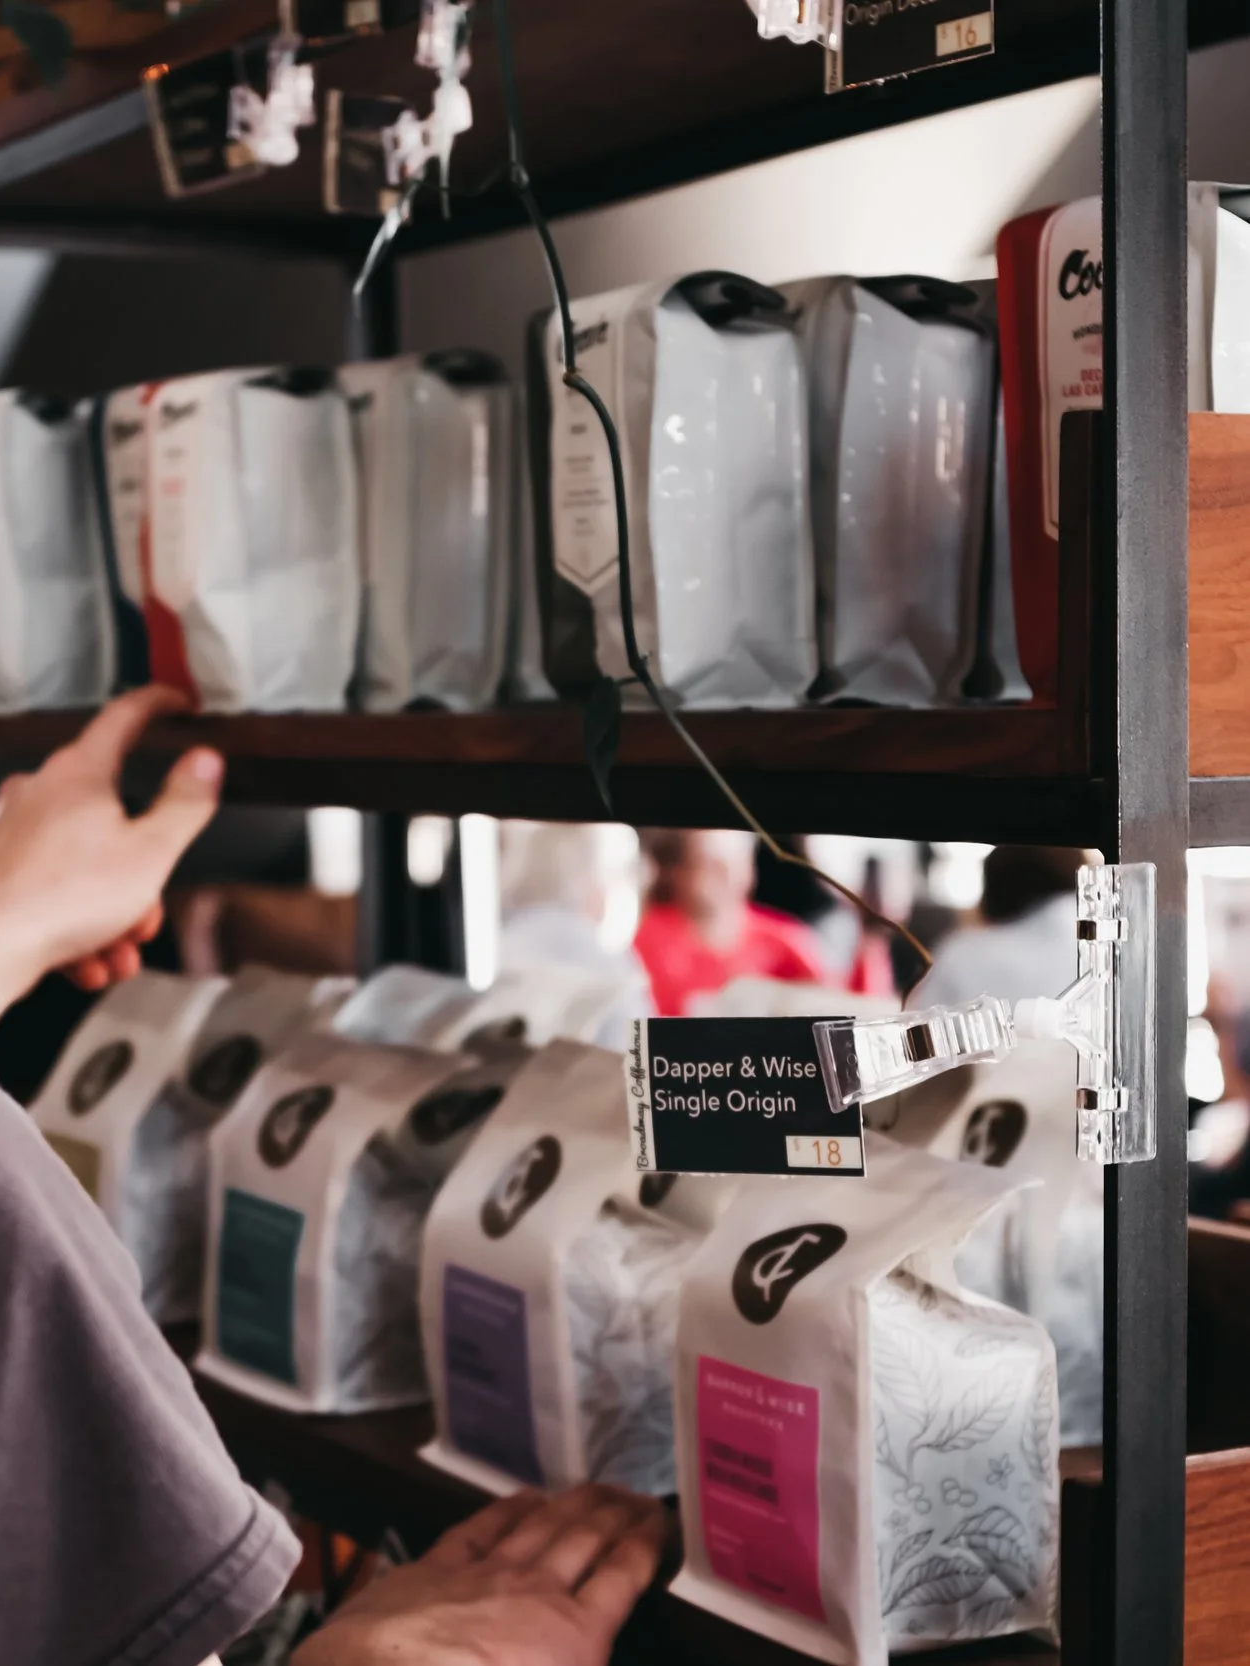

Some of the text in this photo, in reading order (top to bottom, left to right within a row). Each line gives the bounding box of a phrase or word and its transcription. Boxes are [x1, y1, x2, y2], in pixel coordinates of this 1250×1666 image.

[954, 19, 978, 49] 16
[627, 1018, 648, 1099] Coffeehouse
[653, 1056, 818, 1084] Dapper & Wise
[655, 1089, 797, 1119] Single Origin
[811, 1139, 842, 1166] 18
